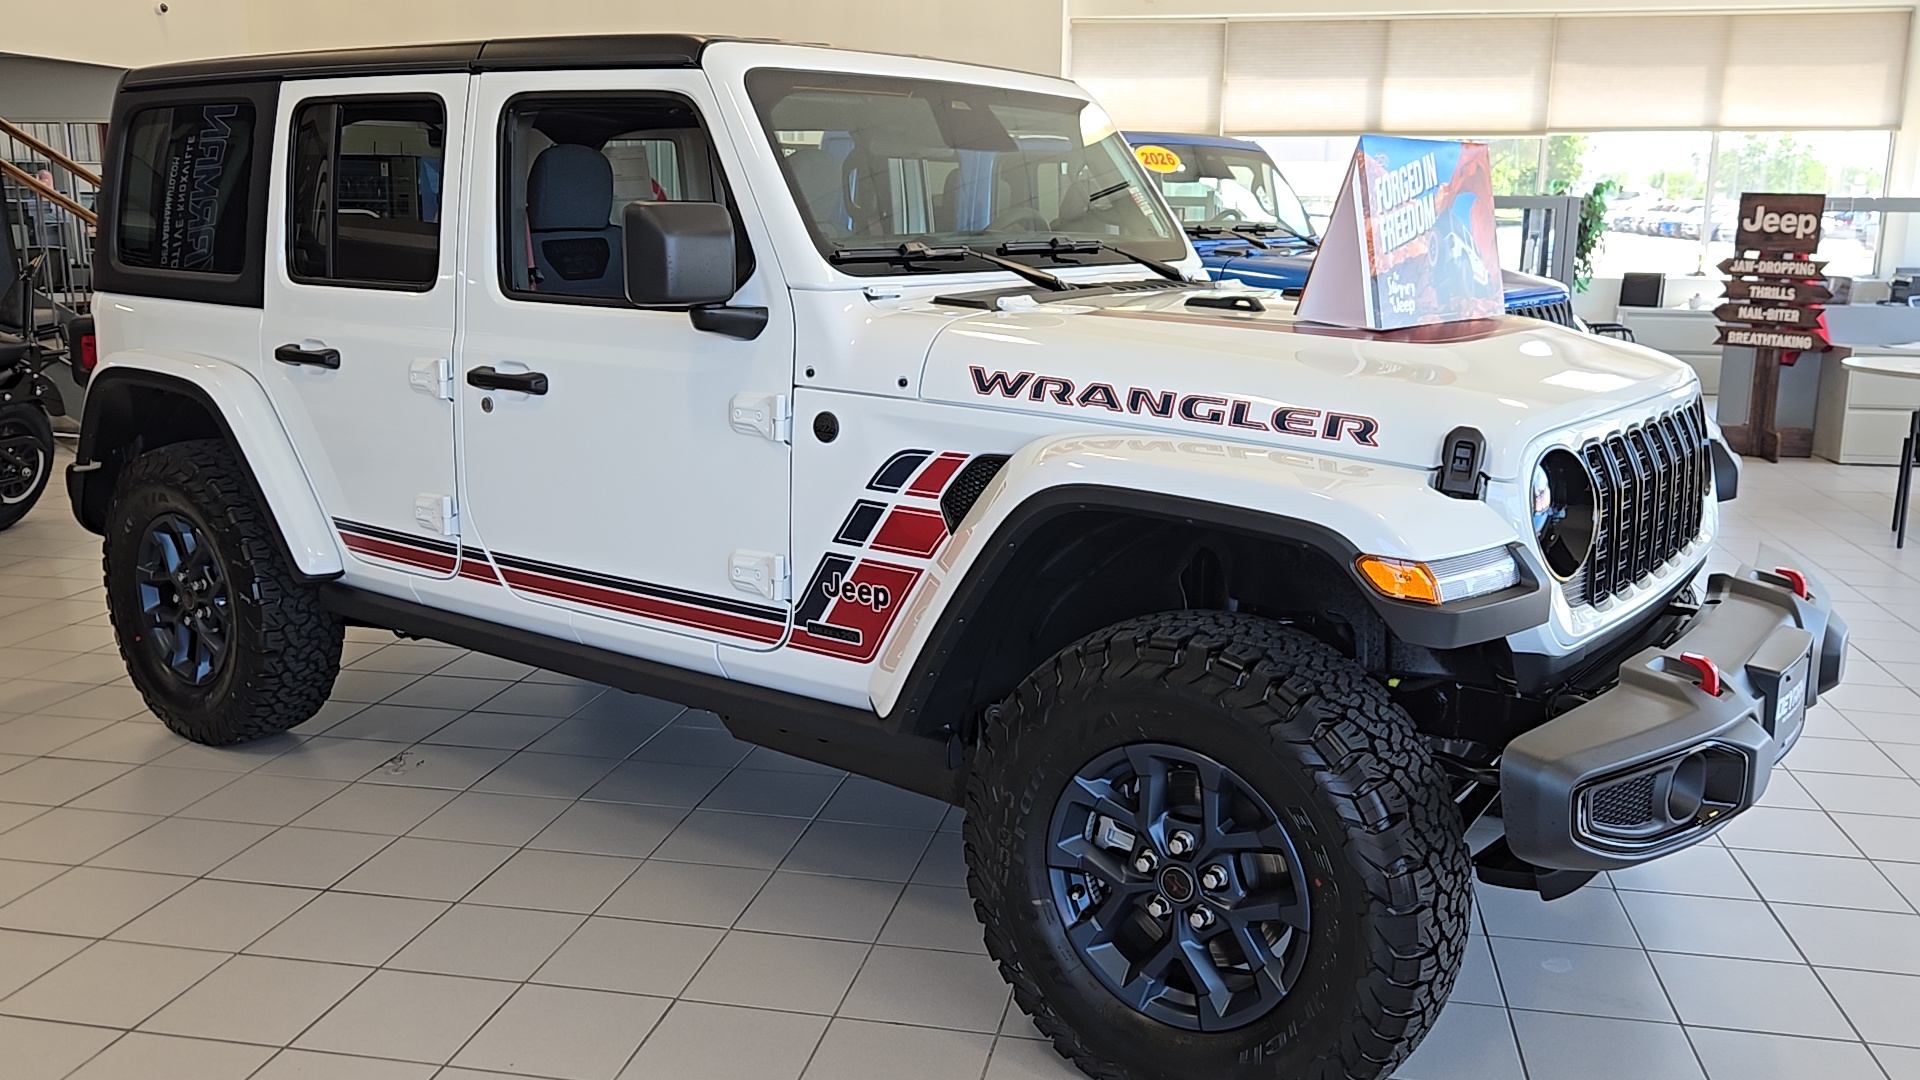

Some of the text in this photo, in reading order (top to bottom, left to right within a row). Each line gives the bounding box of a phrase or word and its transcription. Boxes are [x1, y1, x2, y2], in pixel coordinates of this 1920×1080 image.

[1140, 152, 1175, 166] 2026
[1375, 152, 1438, 214] FORGED IN
[1380, 193, 1436, 254] FREEDOM
[1742, 205, 1817, 240] Jeep
[1729, 260, 1816, 276] JAW-DROPPING
[1749, 285, 1796, 301] THRILLS
[1392, 296, 1416, 316] Jeep
[1737, 306, 1800, 323] NAIL-BITER
[1727, 331, 1813, 350] BREATHTAKING
[968, 364, 1381, 449] WRANGLER
[822, 572, 892, 613] Jeep
